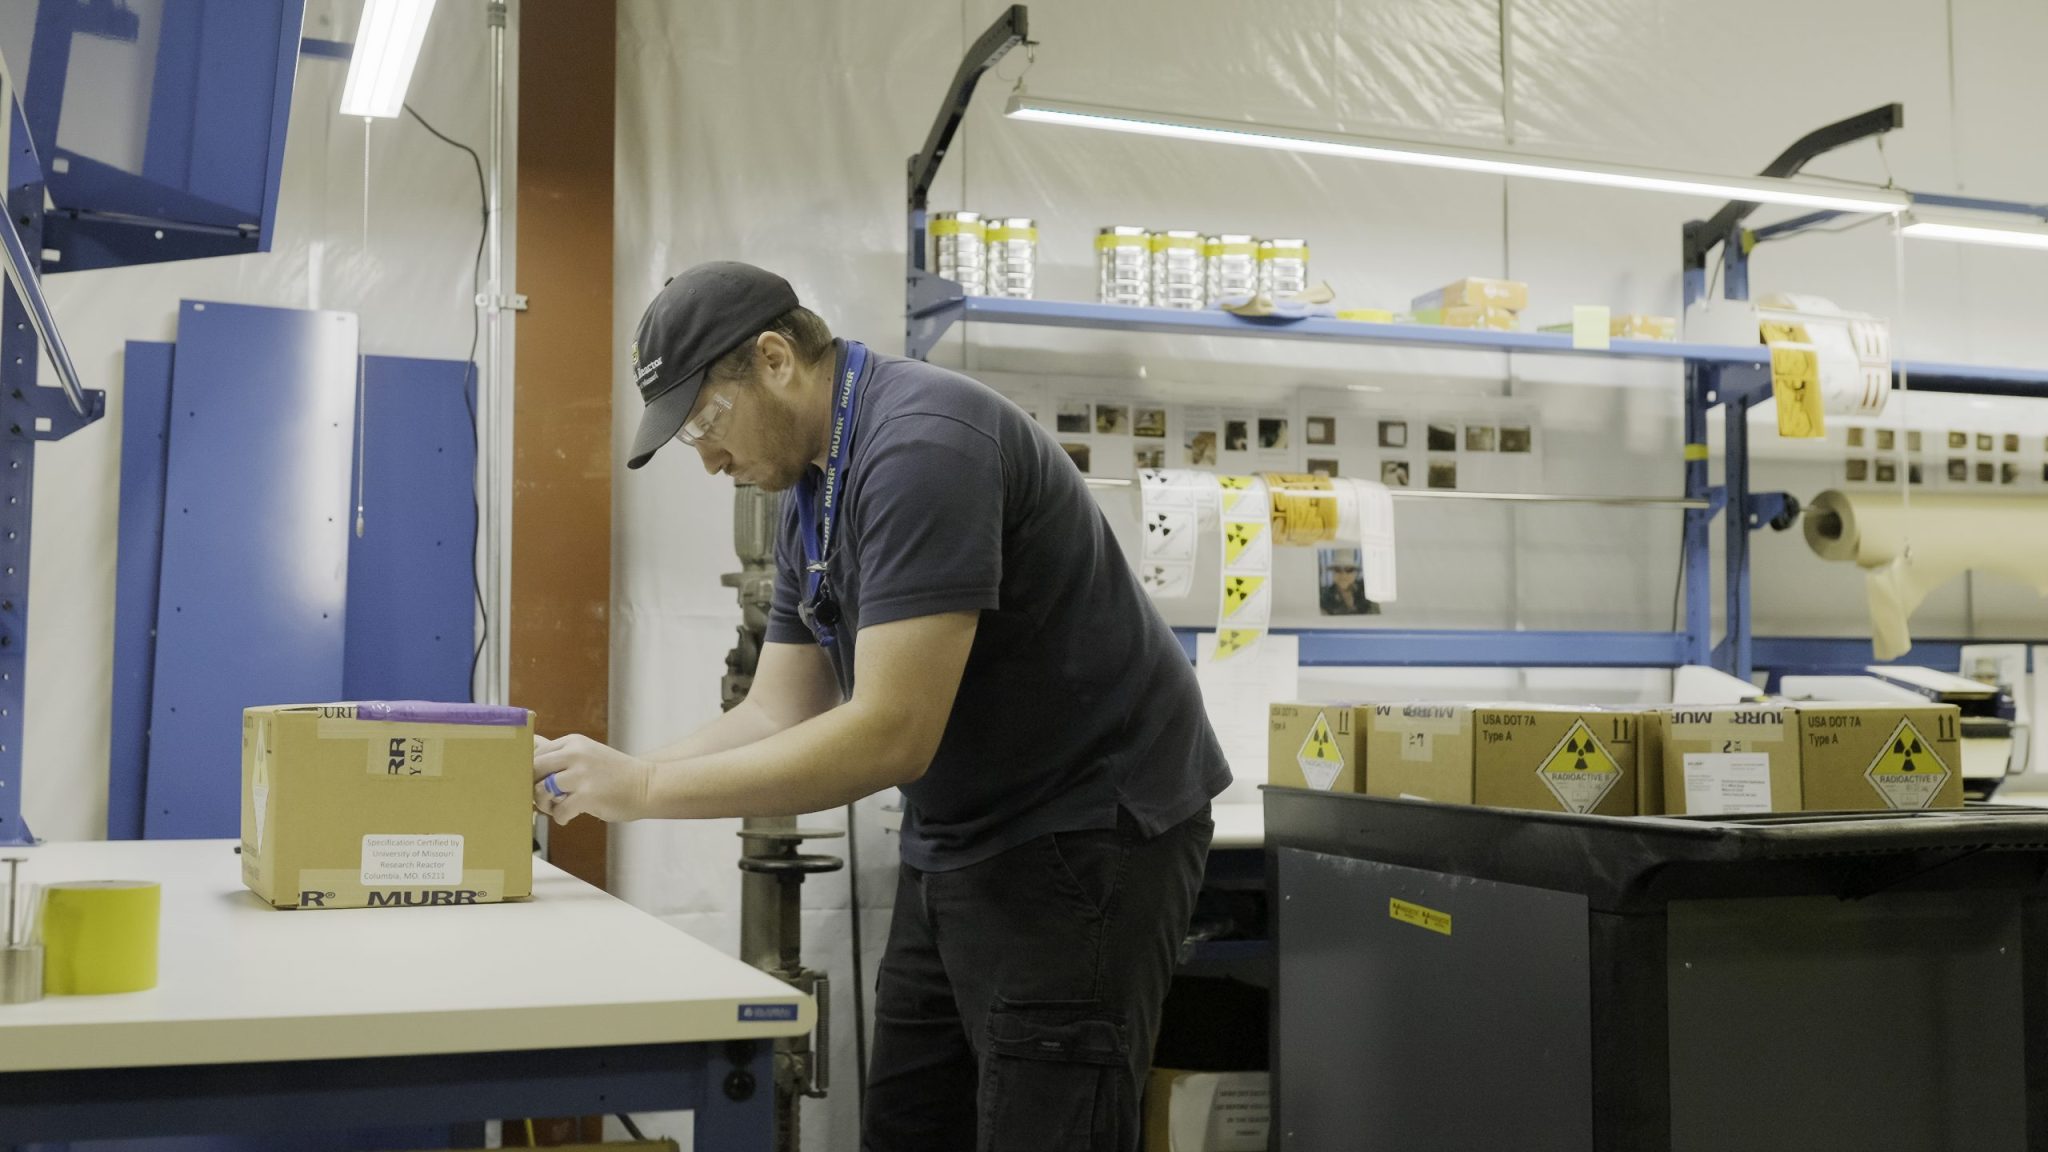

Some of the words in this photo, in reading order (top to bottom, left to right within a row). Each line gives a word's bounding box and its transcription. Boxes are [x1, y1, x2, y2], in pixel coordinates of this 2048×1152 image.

[1482, 714, 1502, 726] USA
[1503, 714, 1522, 726] DOT
[1523, 715, 1537, 726] 7A
[1808, 715, 1827, 728] USA
[1829, 715, 1848, 728] DOT
[1849, 715, 1862, 728] 7A
[1482, 730, 1504, 744] Type
[1505, 730, 1513, 741] A
[1808, 733, 1830, 748] Type
[1831, 732, 1839, 744] A
[1551, 773, 1602, 781] RADIOACTIVE
[1880, 775, 1931, 783] RADIOACTIVE
[367, 839, 415, 847] Specification
[416, 839, 449, 847] Certified
[450, 839, 460, 848] by
[372, 850, 410, 859] University
[411, 850, 420, 858] of
[421, 850, 454, 858] Missouri
[380, 861, 415, 869] Research
[416, 861, 445, 869] Reactor
